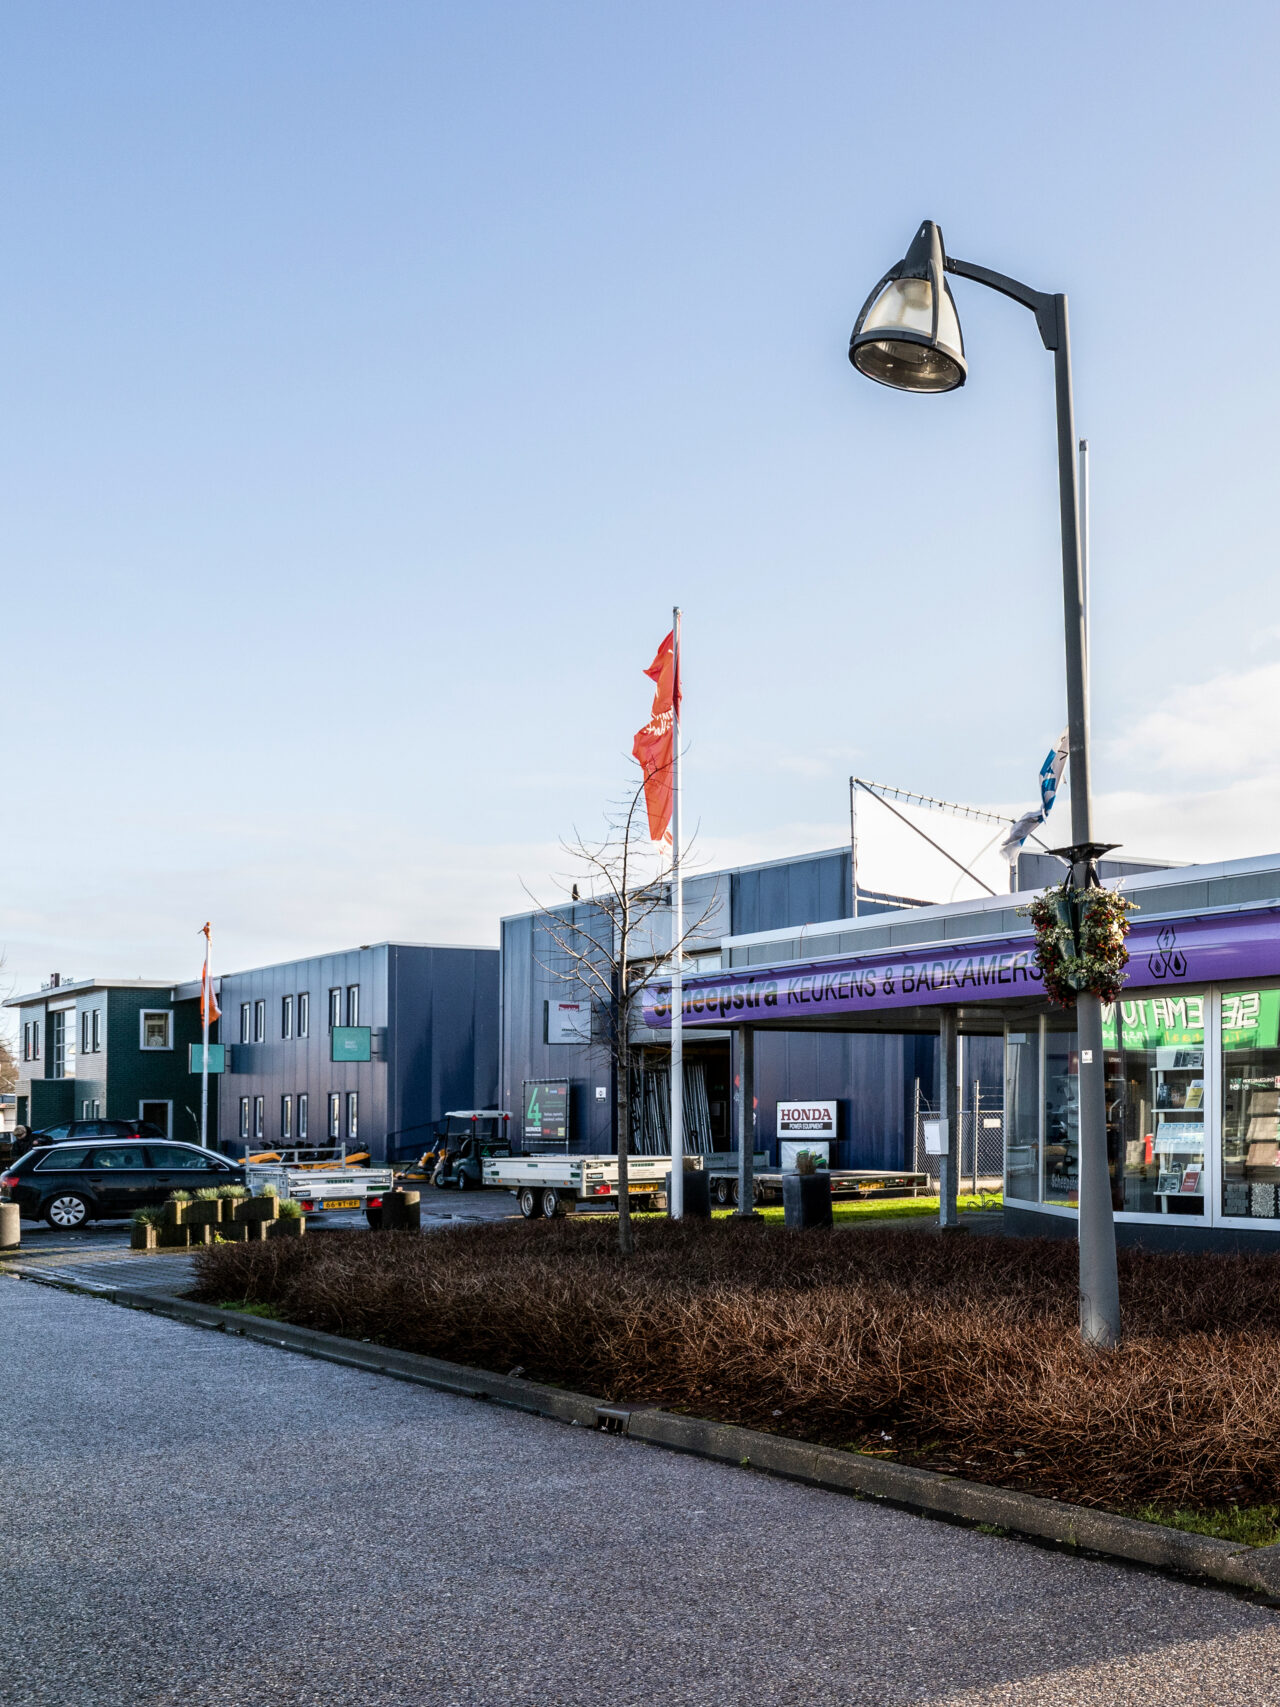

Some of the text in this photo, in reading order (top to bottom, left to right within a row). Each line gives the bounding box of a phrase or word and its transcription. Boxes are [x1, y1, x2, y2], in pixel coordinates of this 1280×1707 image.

[653, 949, 1045, 1018] Sheepstra KEUKENS & BADKAMERS
[780, 1108, 833, 1121] HONDA
